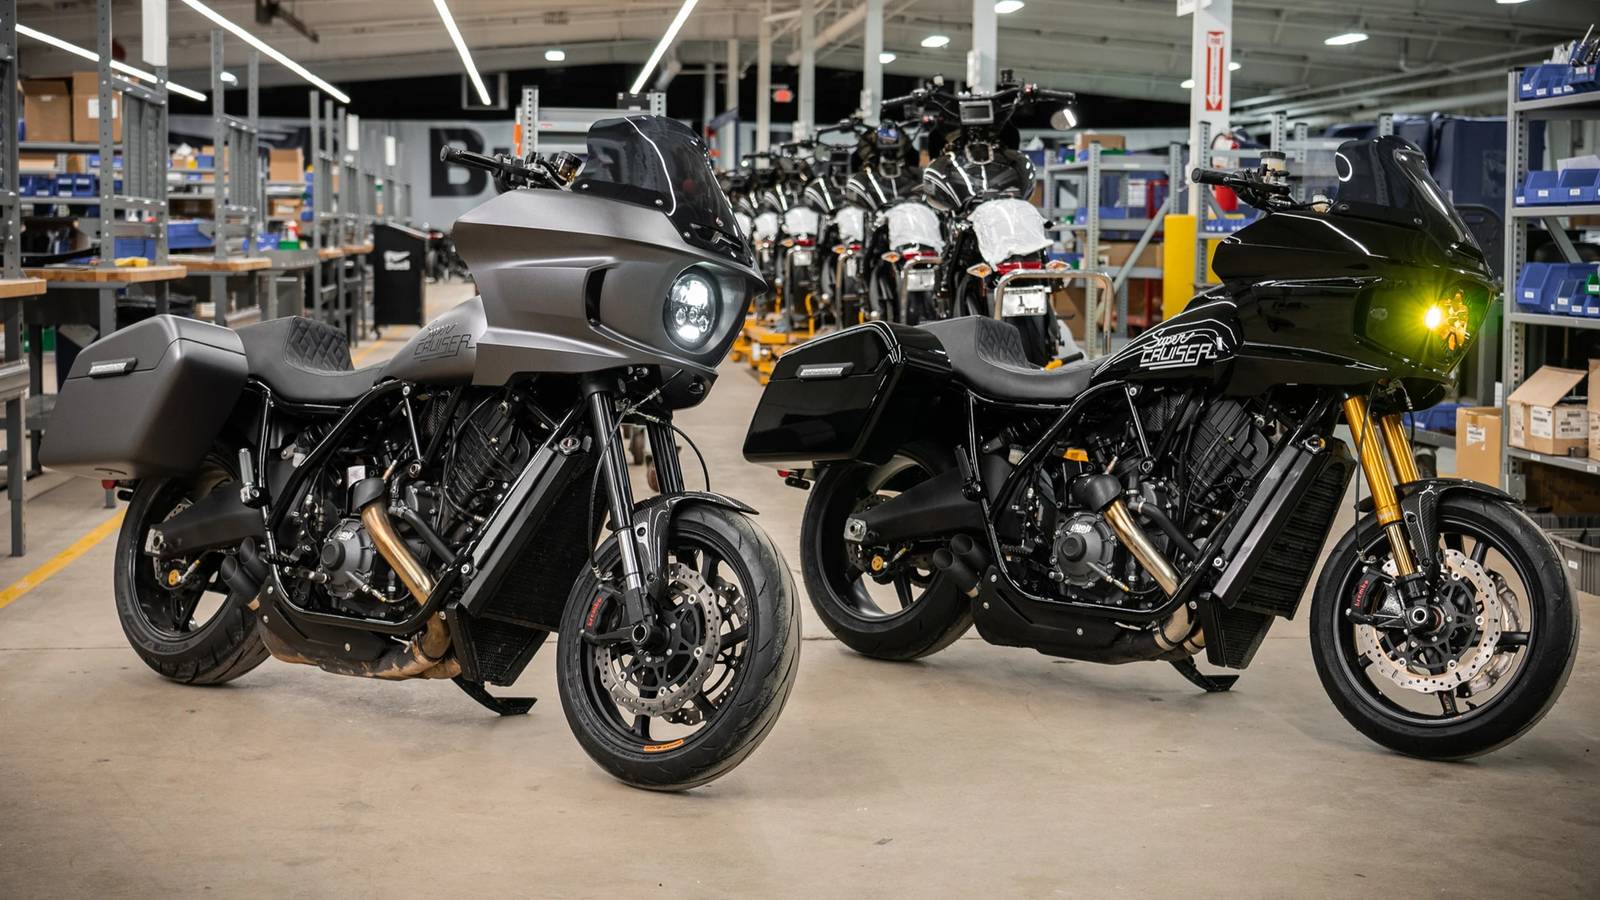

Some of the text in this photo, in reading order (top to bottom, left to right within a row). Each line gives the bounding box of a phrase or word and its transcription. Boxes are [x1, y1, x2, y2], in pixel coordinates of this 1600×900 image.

[419, 319, 458, 342] Super
[1142, 327, 1196, 350] Super
[413, 333, 476, 360] CRUISER
[1139, 343, 1218, 369] CRUISER
